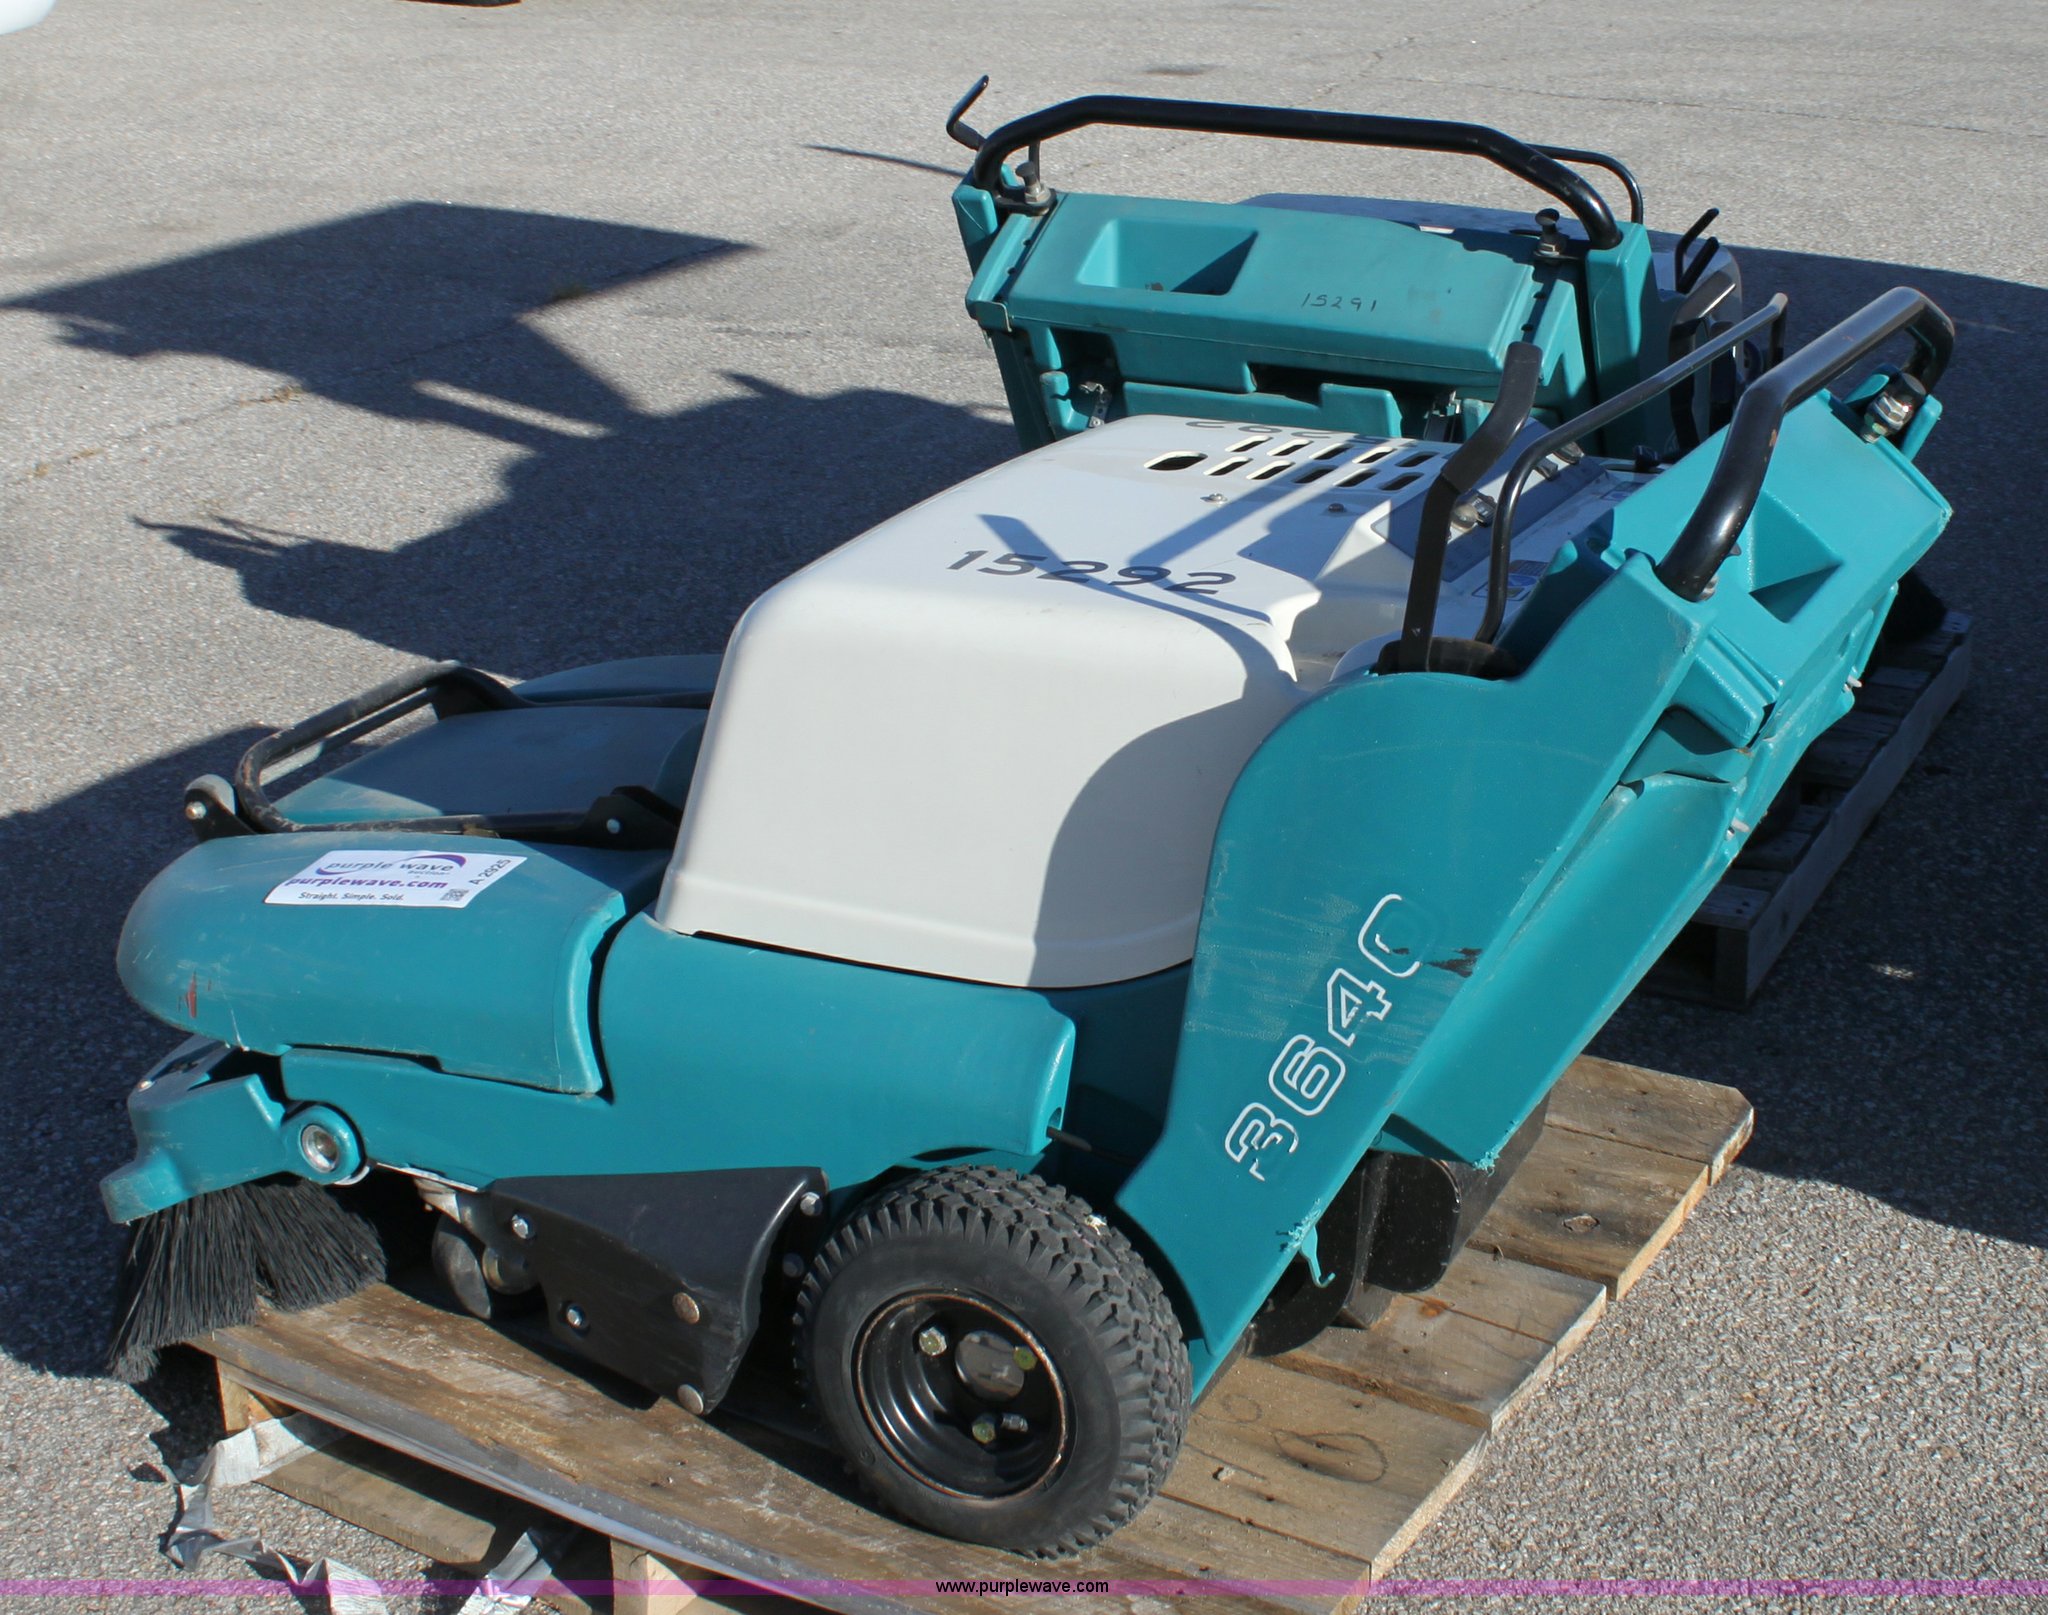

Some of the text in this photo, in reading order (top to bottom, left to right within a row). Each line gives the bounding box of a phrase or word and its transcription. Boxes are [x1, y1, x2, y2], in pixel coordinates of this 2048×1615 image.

[1300, 292, 1377, 312] 15291
[947, 549, 1237, 595] 15292
[325, 861, 454, 872] purple wave
[284, 876, 448, 889] purplewave.com
[298, 891, 404, 901] Straight. Simple. Sold.
